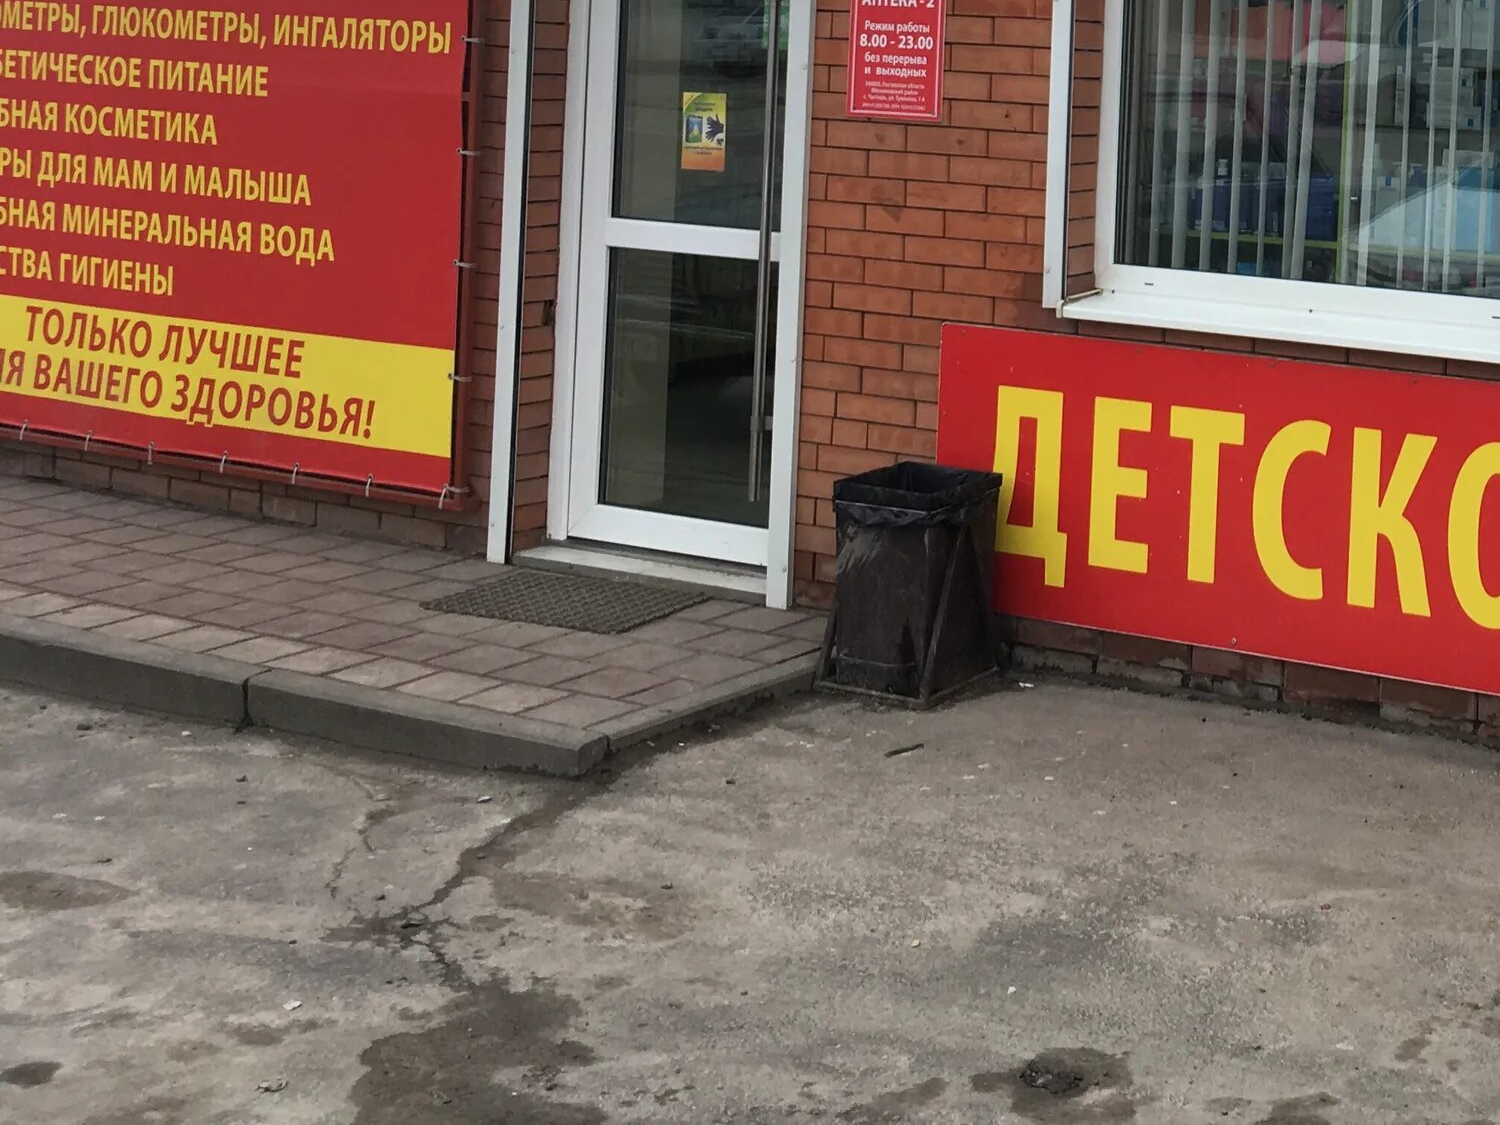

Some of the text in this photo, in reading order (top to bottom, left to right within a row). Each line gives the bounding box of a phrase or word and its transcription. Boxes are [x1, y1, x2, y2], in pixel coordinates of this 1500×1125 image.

[0, 0, 452, 54] МЕТРЫ, ГЛЮКОМЕТРЫ, ИНГАЛЯТОРЫ
[860, 34, 887, 48] 8.00
[898, 36, 933, 50] 23.00
[864, 20, 930, 33] Режим работы
[148, 60, 269, 97] ПИТАНИЕ
[864, 52, 927, 66] без перерыва
[864, 67, 926, 78] и выходных
[65, 103, 217, 145] КОСМЕТИКА
[37, 151, 86, 188] ДЛЯ
[93, 156, 153, 191] МАМ
[160, 162, 177, 193] И
[184, 164, 311, 206] МАЛЫША
[62, 204, 251, 253] МИНЕРАЛЬНАЯ
[260, 224, 335, 266] ВОДА
[59, 253, 173, 296] ГИГИЕНЫ
[25, 305, 305, 379] ТОЛЬКО ЛУЧШЕЕ
[33, 353, 163, 408] ВАШЕГО
[170, 374, 376, 440] ЗДОРОВЬЯ!
